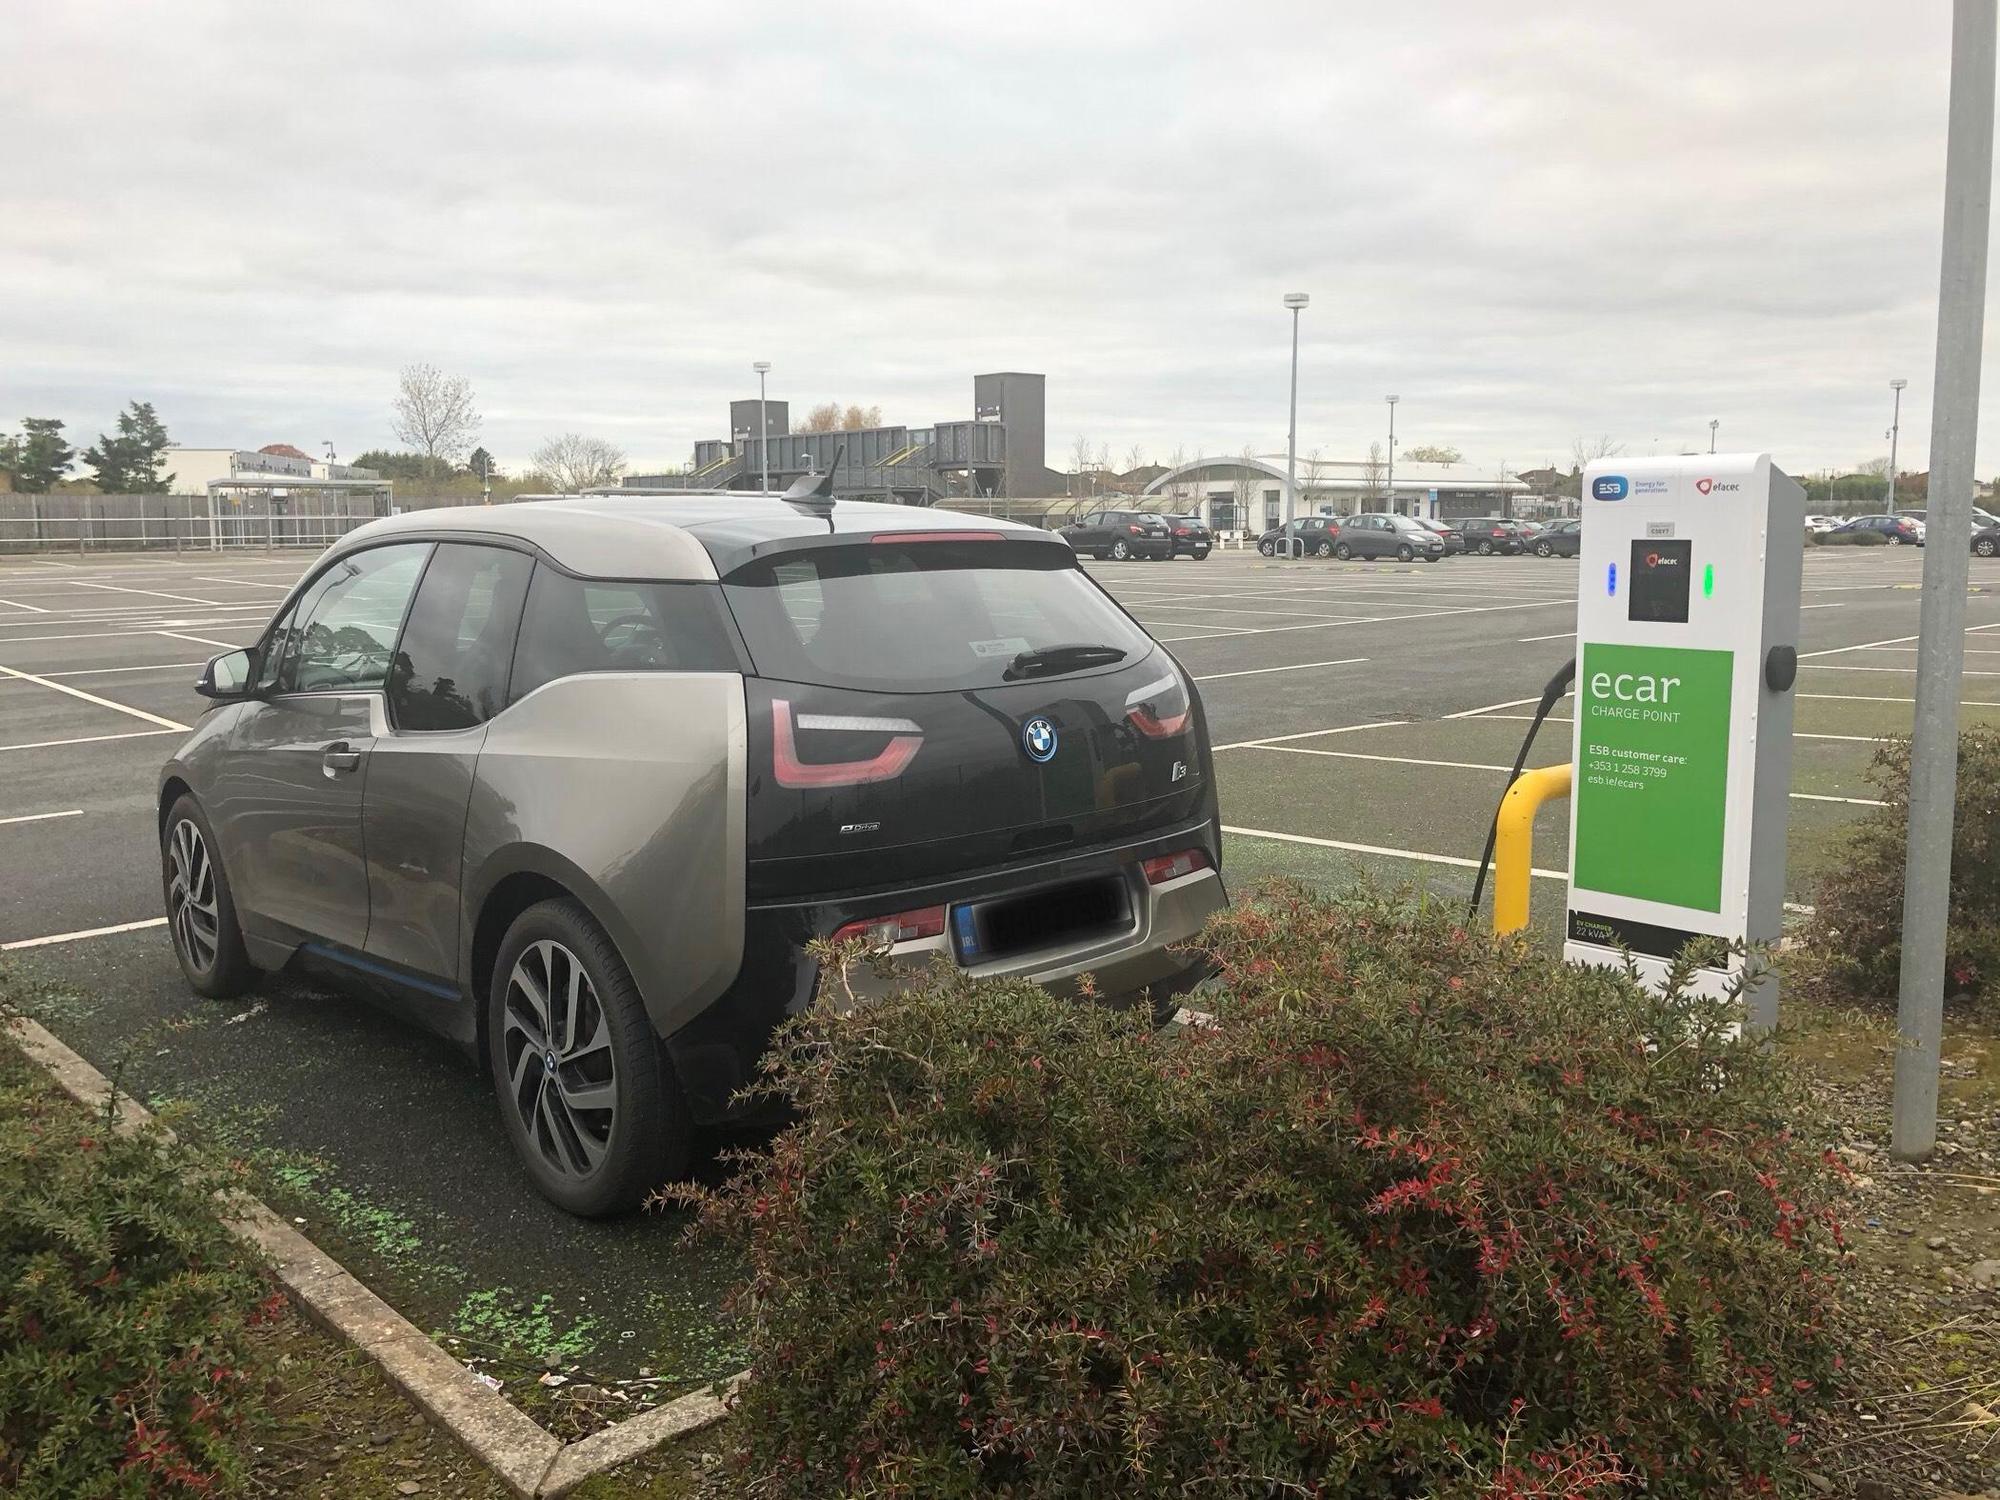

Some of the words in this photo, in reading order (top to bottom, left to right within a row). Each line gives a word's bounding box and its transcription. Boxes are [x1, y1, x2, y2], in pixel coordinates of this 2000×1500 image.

[1599, 483, 1621, 494] ESB
[1635, 487, 1668, 495] generations
[1713, 482, 1740, 491] efacec
[1657, 557, 1677, 565] efacec
[1591, 672, 1681, 703] ecar
[1591, 705, 1640, 719] CHARGE
[1643, 709, 1681, 722] POINT
[1589, 744, 1610, 756] ESB
[1611, 749, 1660, 761] customer
[1662, 754, 1688, 765] care:
[1588, 760, 1611, 771] +353
[1621, 764, 1640, 775] 258
[1642, 766, 1667, 778] 3799
[1588, 775, 1644, 789] esb.ie/ecars
[1576, 927, 1586, 936] 22
[961, 935, 975, 948] IRL
